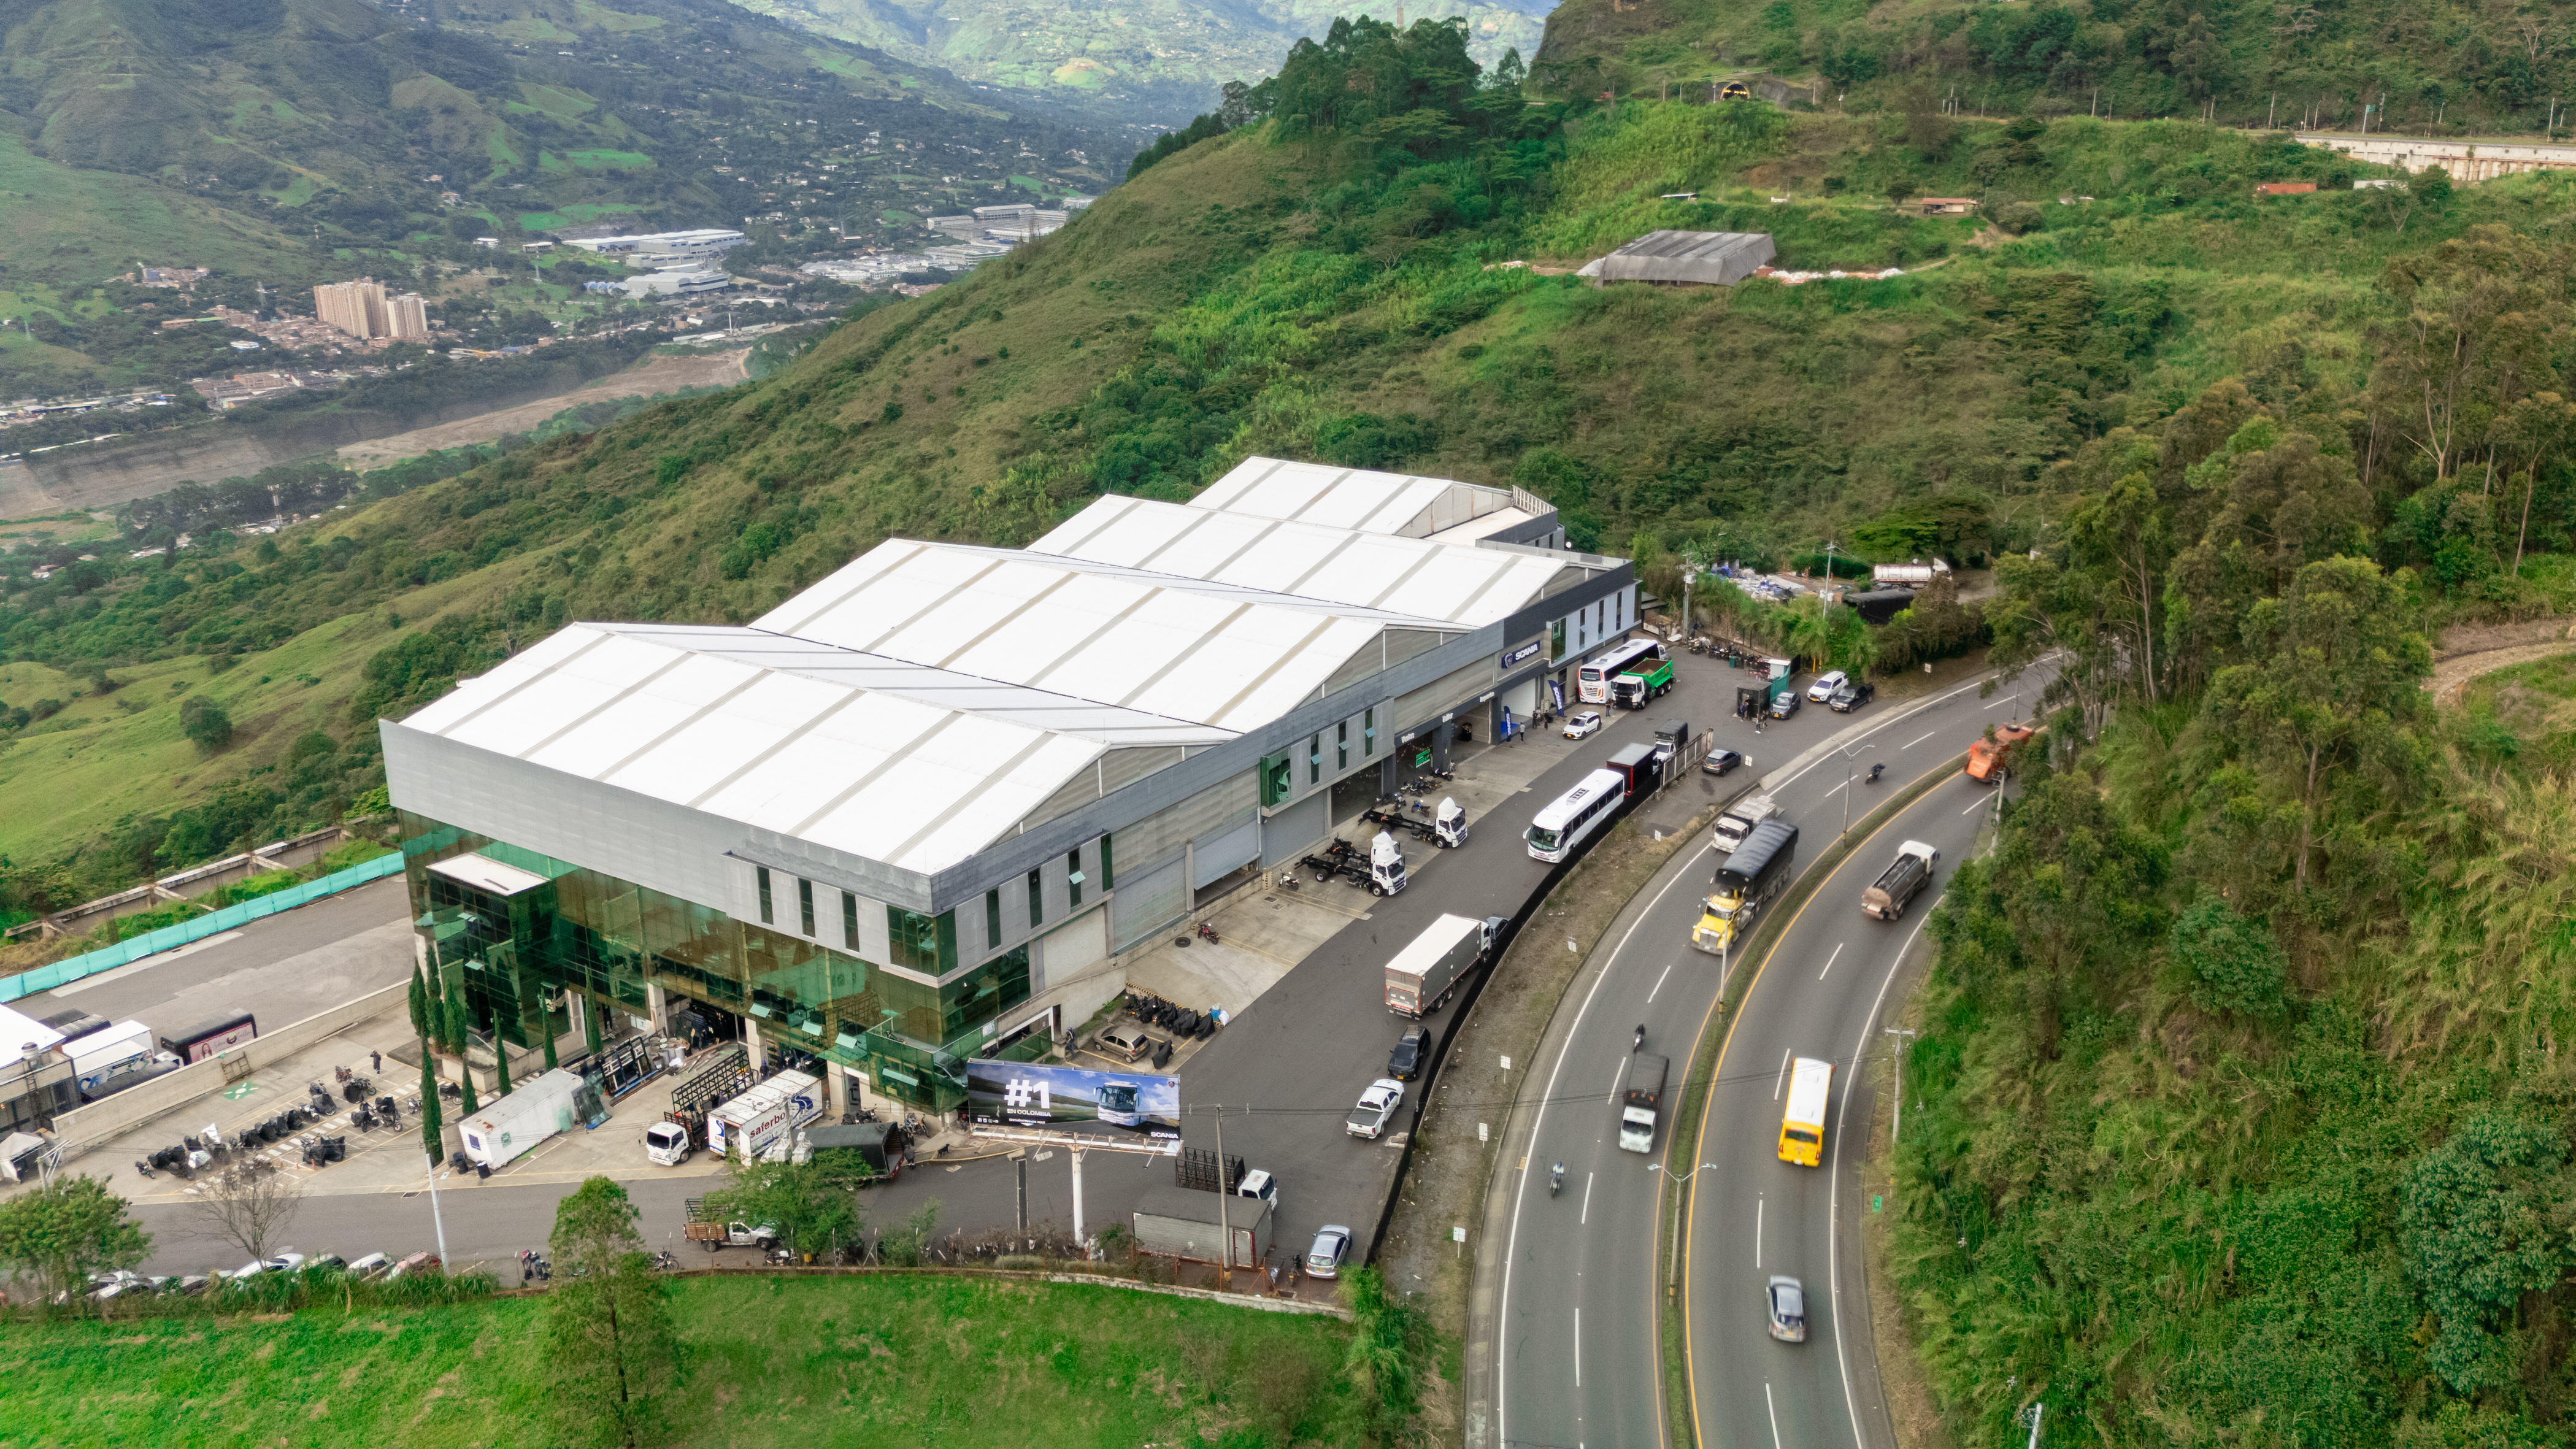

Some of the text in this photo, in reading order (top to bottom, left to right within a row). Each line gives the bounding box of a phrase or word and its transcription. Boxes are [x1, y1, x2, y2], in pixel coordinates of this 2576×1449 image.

[1515, 644, 1538, 661] SCANIA
[1553, 686, 1563, 710] SCANIA
[1004, 1078, 1050, 1109] #1
[750, 1112, 786, 1139] saferbo
